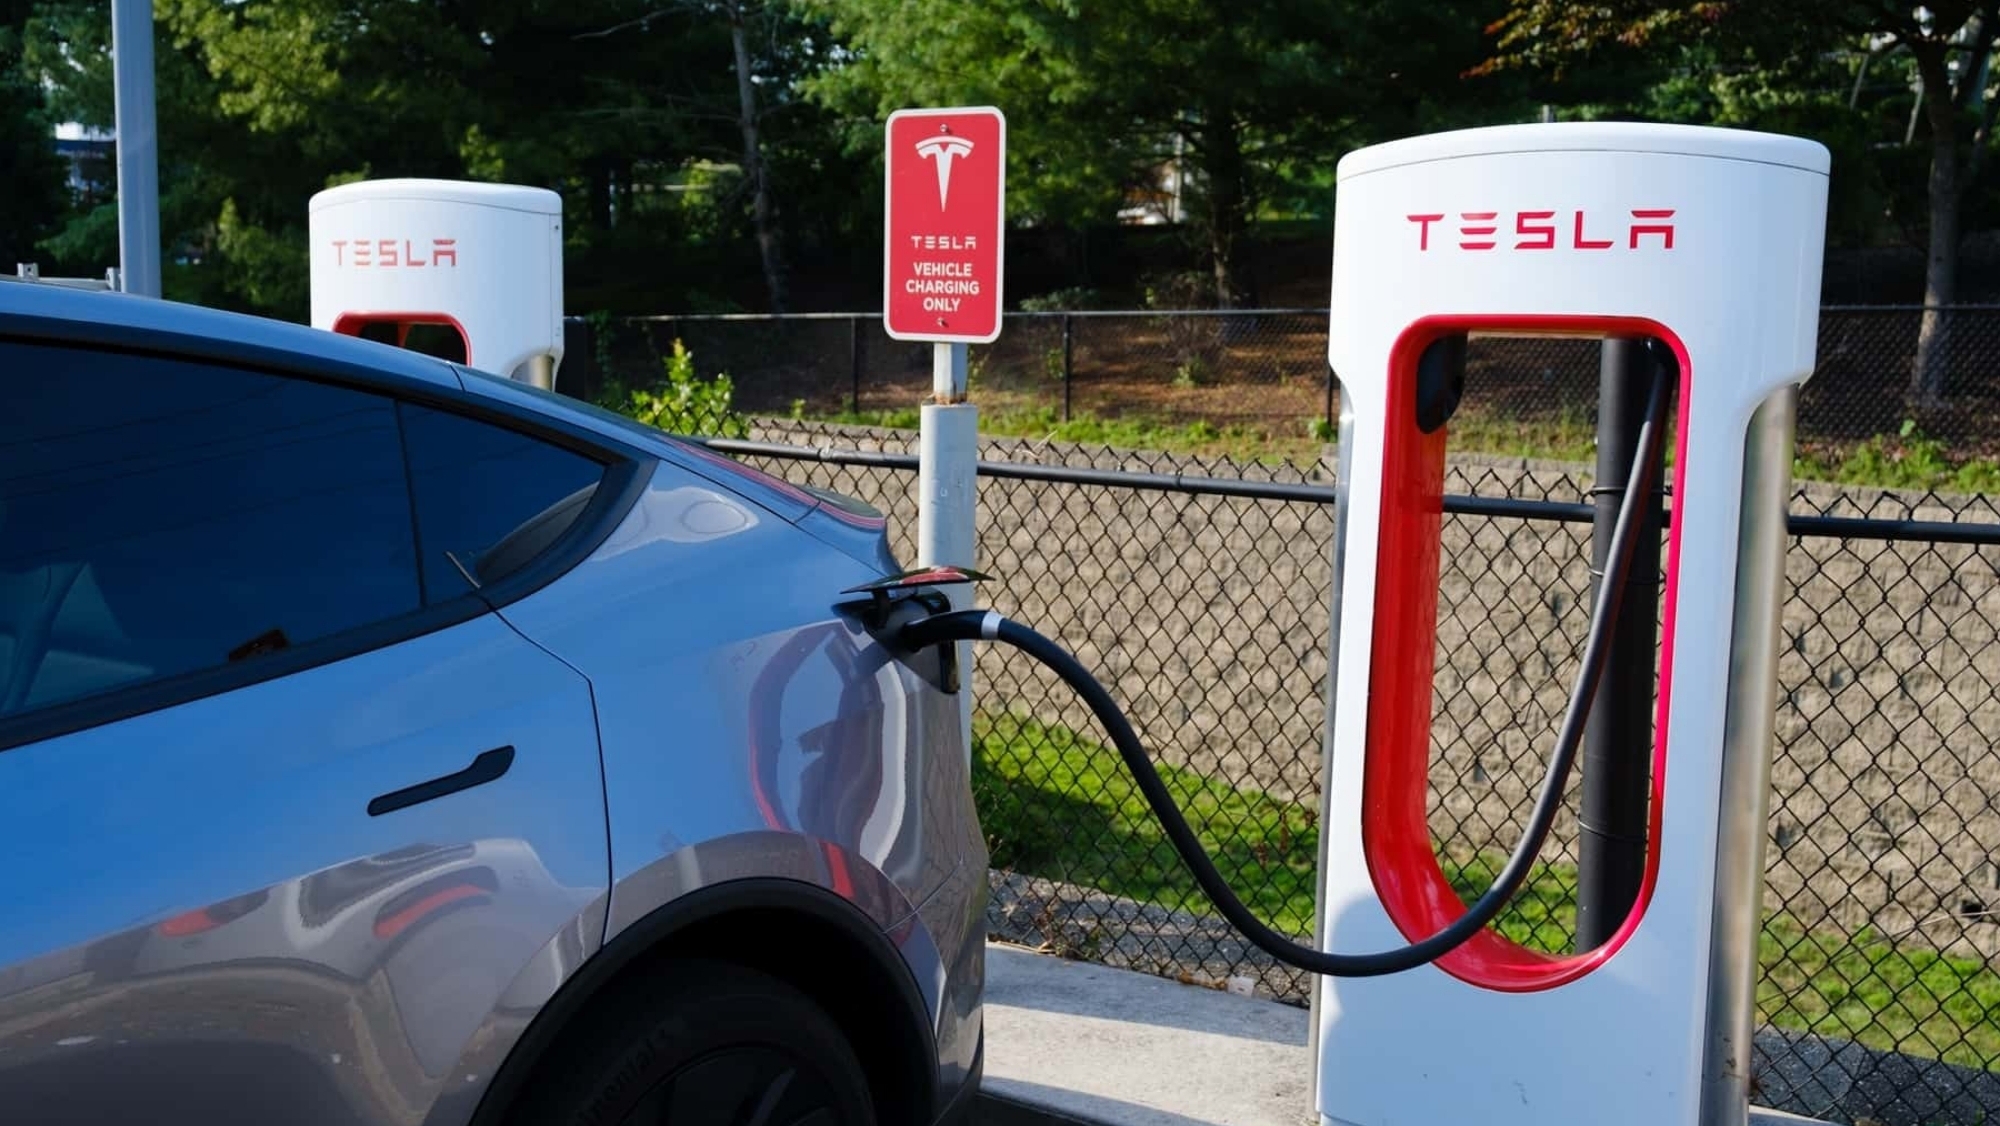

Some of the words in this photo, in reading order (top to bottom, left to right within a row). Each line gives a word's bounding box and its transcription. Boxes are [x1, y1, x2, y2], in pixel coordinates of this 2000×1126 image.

[1406, 209, 1675, 251] TESLA
[911, 235, 976, 249] TESLA
[331, 238, 457, 267] TESLA
[913, 262, 973, 277] VEHICLE
[905, 279, 980, 295] CHARGING
[922, 297, 961, 312] ONLY
